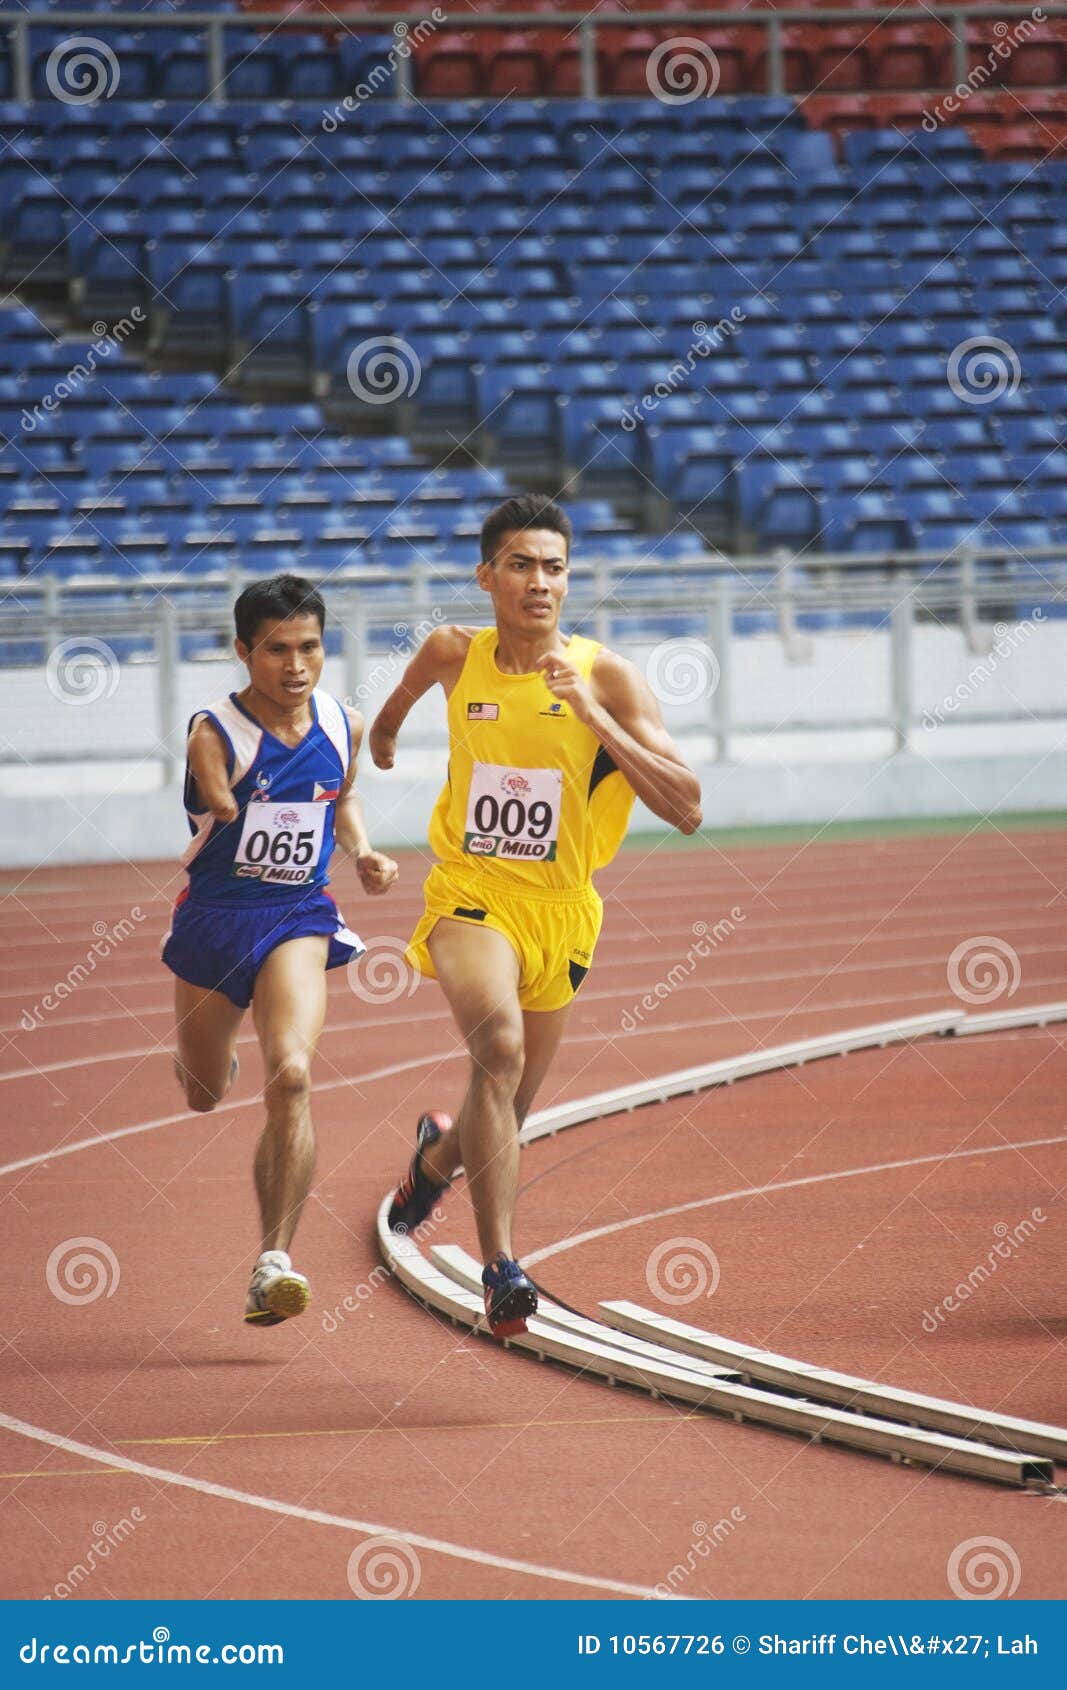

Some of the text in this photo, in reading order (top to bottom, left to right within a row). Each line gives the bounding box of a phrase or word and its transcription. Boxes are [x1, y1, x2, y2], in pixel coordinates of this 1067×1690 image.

[474, 795, 552, 839] 009
[245, 830, 315, 865] 065
[501, 841, 546, 857] MILO
[266, 868, 305, 881] MILO
